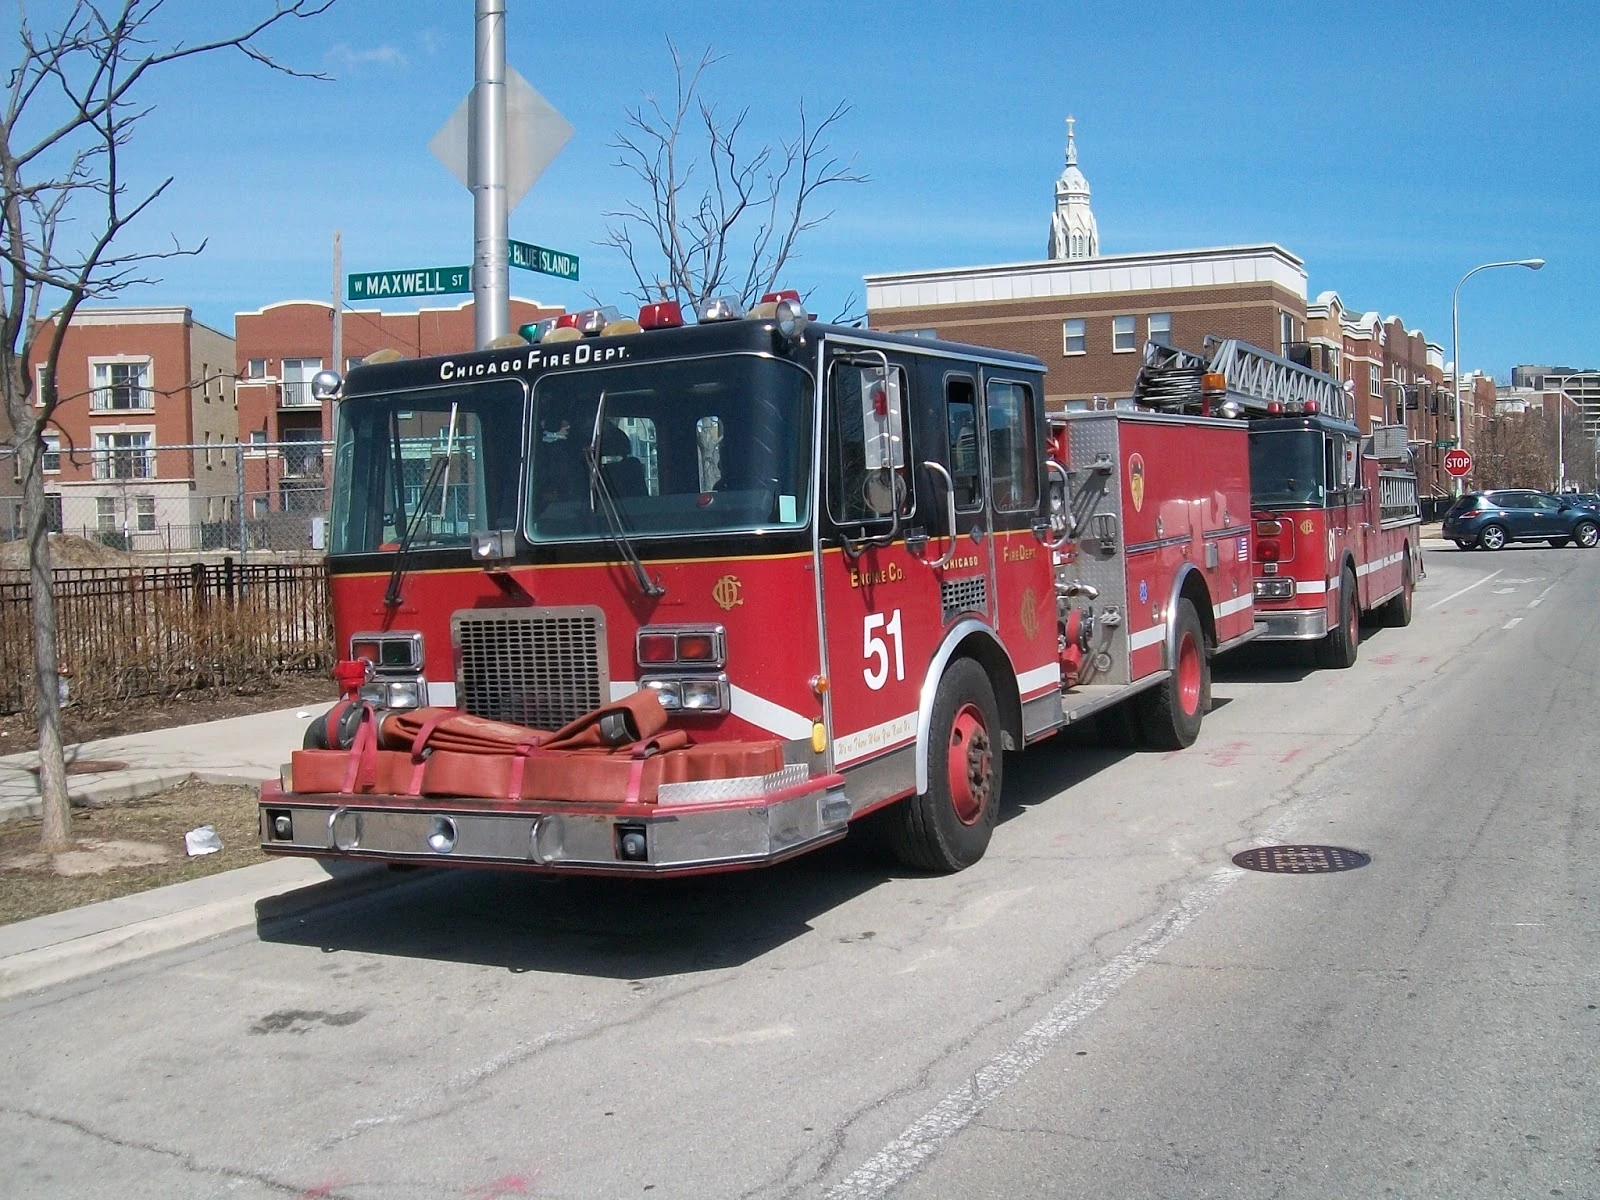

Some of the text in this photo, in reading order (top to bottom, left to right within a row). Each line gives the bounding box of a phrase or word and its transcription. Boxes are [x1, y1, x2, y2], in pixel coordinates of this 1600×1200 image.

[513, 243, 538, 269] BLUE
[538, 250, 570, 276] ISLAND
[354, 271, 464, 296] W MAXWELL ST
[440, 361, 522, 380] CHICAGO
[527, 350, 570, 370] FIRE
[1446, 457, 1470, 469] STOP
[942, 552, 979, 571] CHICAGO
[850, 567, 887, 588] ENGINE
[863, 608, 905, 691] 51
